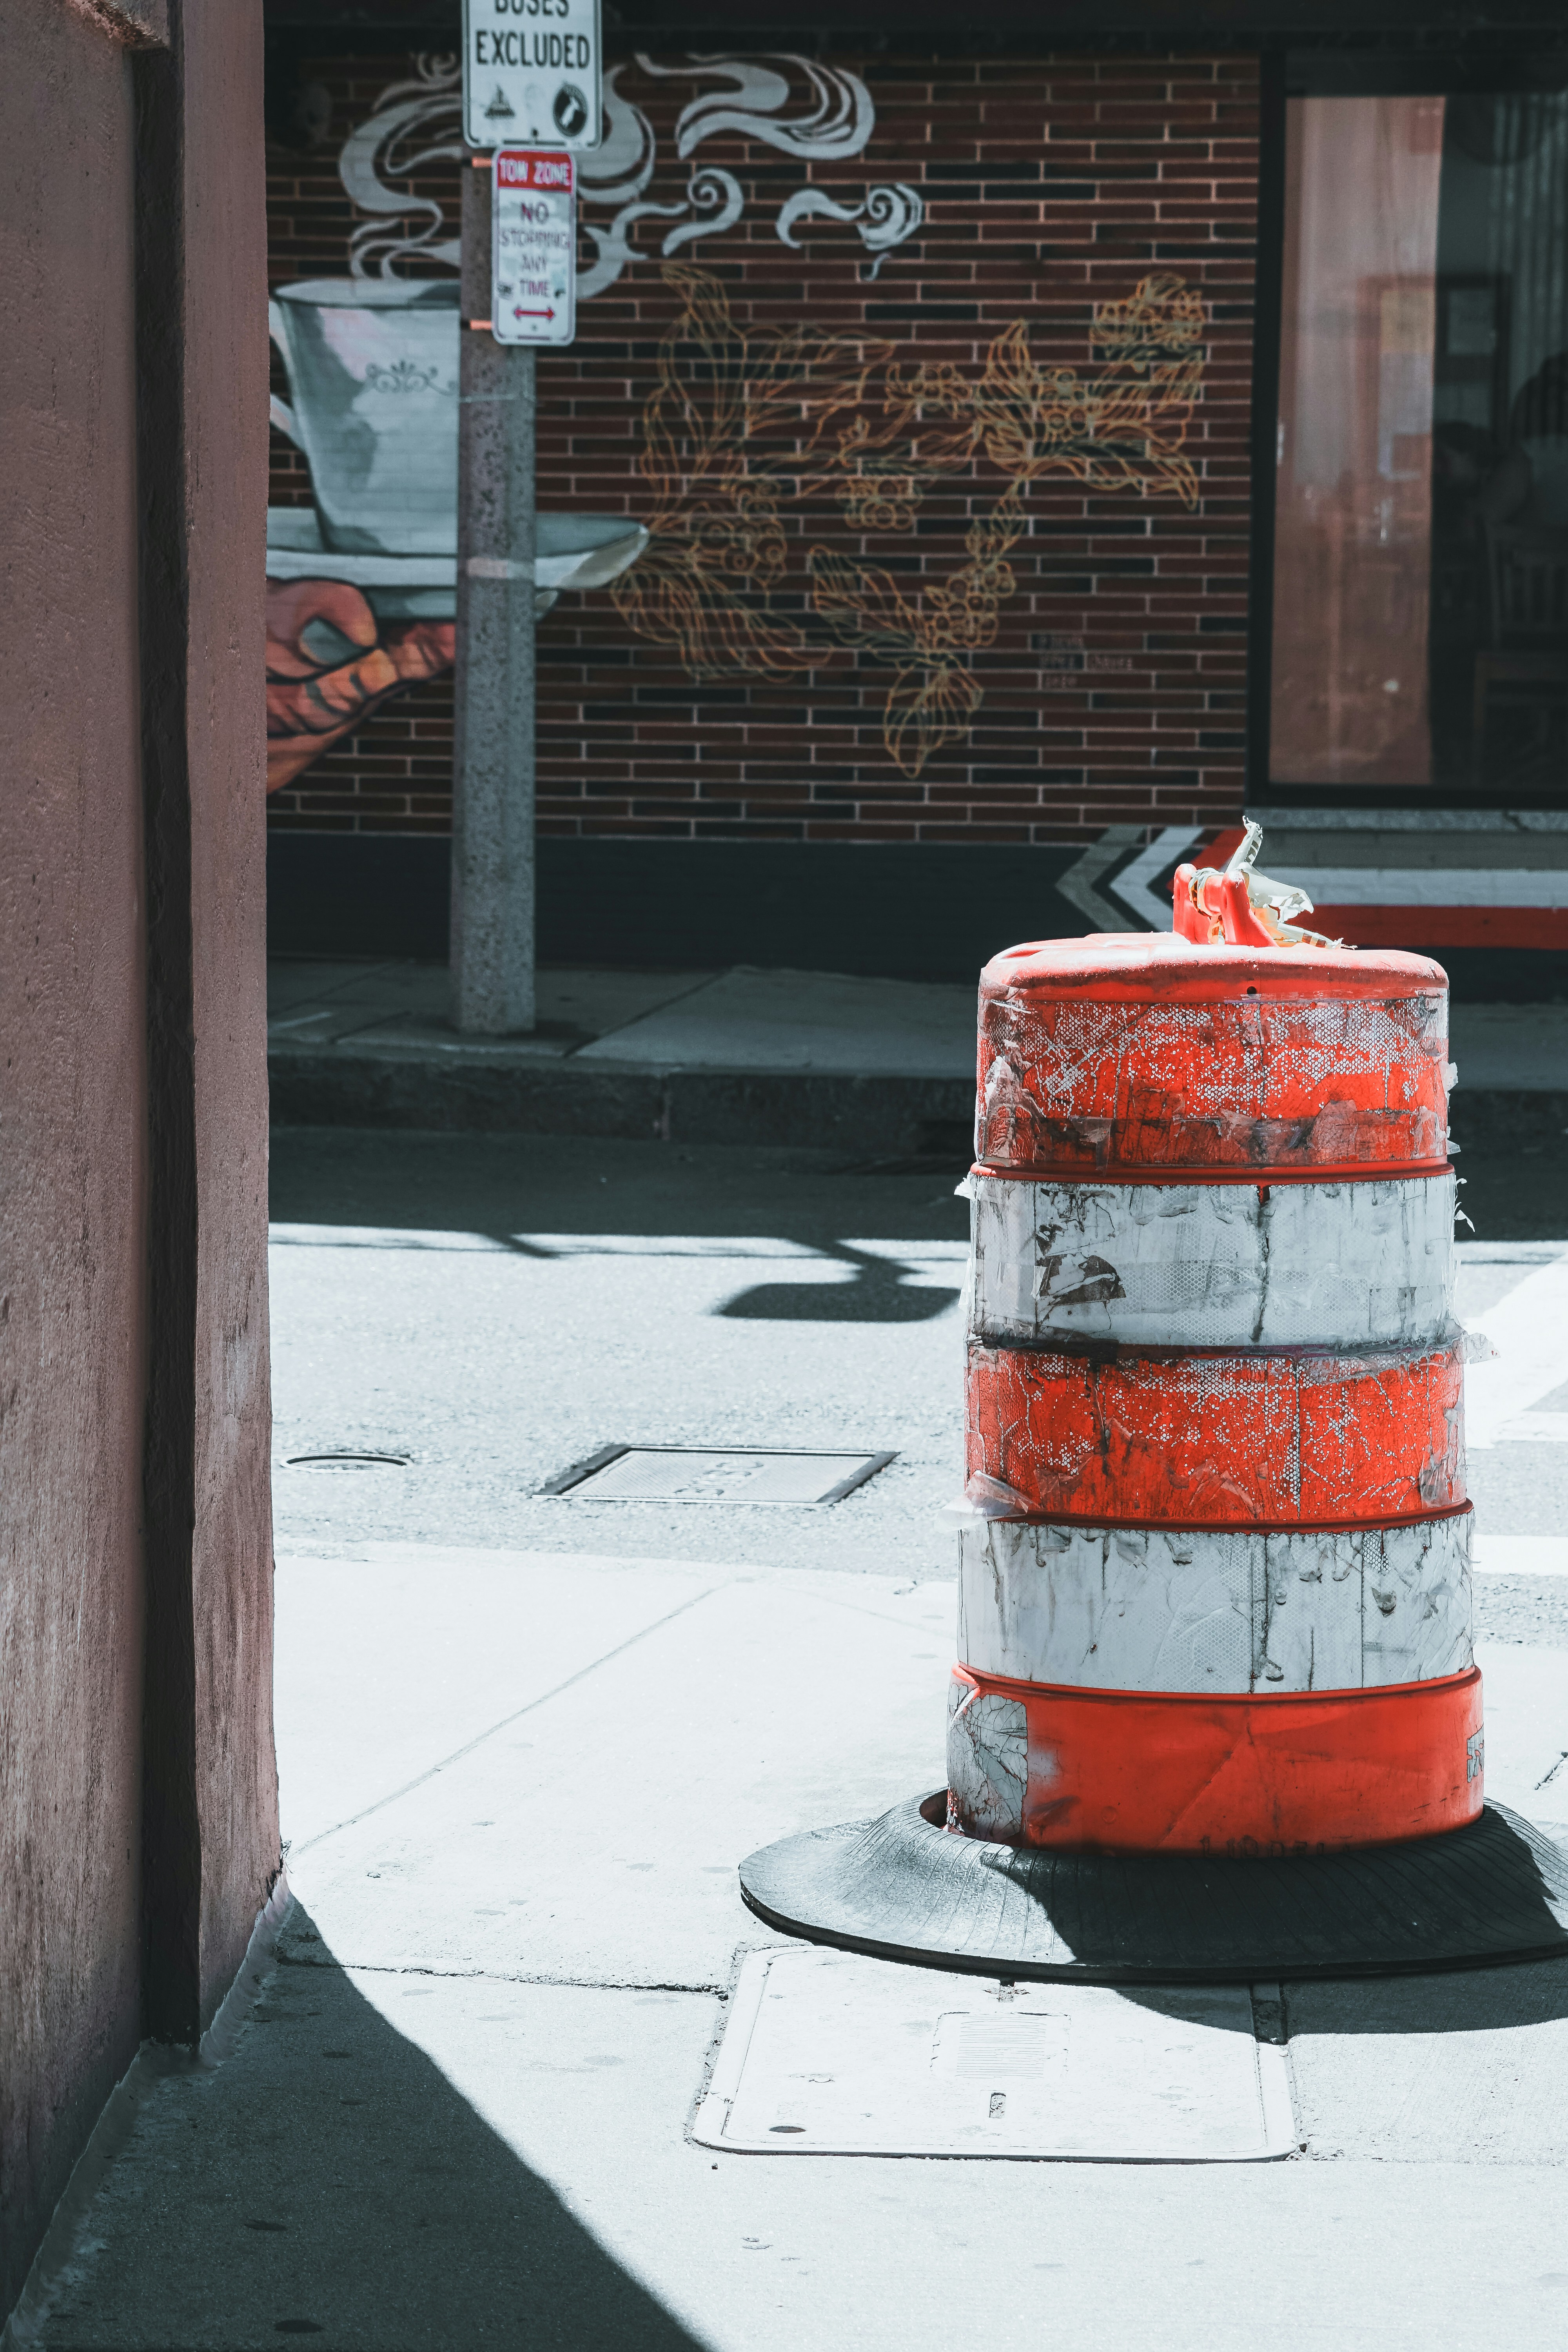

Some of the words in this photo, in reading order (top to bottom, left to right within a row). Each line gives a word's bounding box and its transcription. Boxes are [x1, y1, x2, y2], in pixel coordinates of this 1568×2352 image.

[474, 29, 590, 70] EXCLUDED
[500, 158, 529, 182] TOW
[533, 161, 571, 187] ZONE
[520, 202, 550, 226] NO
[499, 227, 571, 250] STOPPING
[520, 254, 547, 272] ANY
[519, 279, 550, 298] TIME
